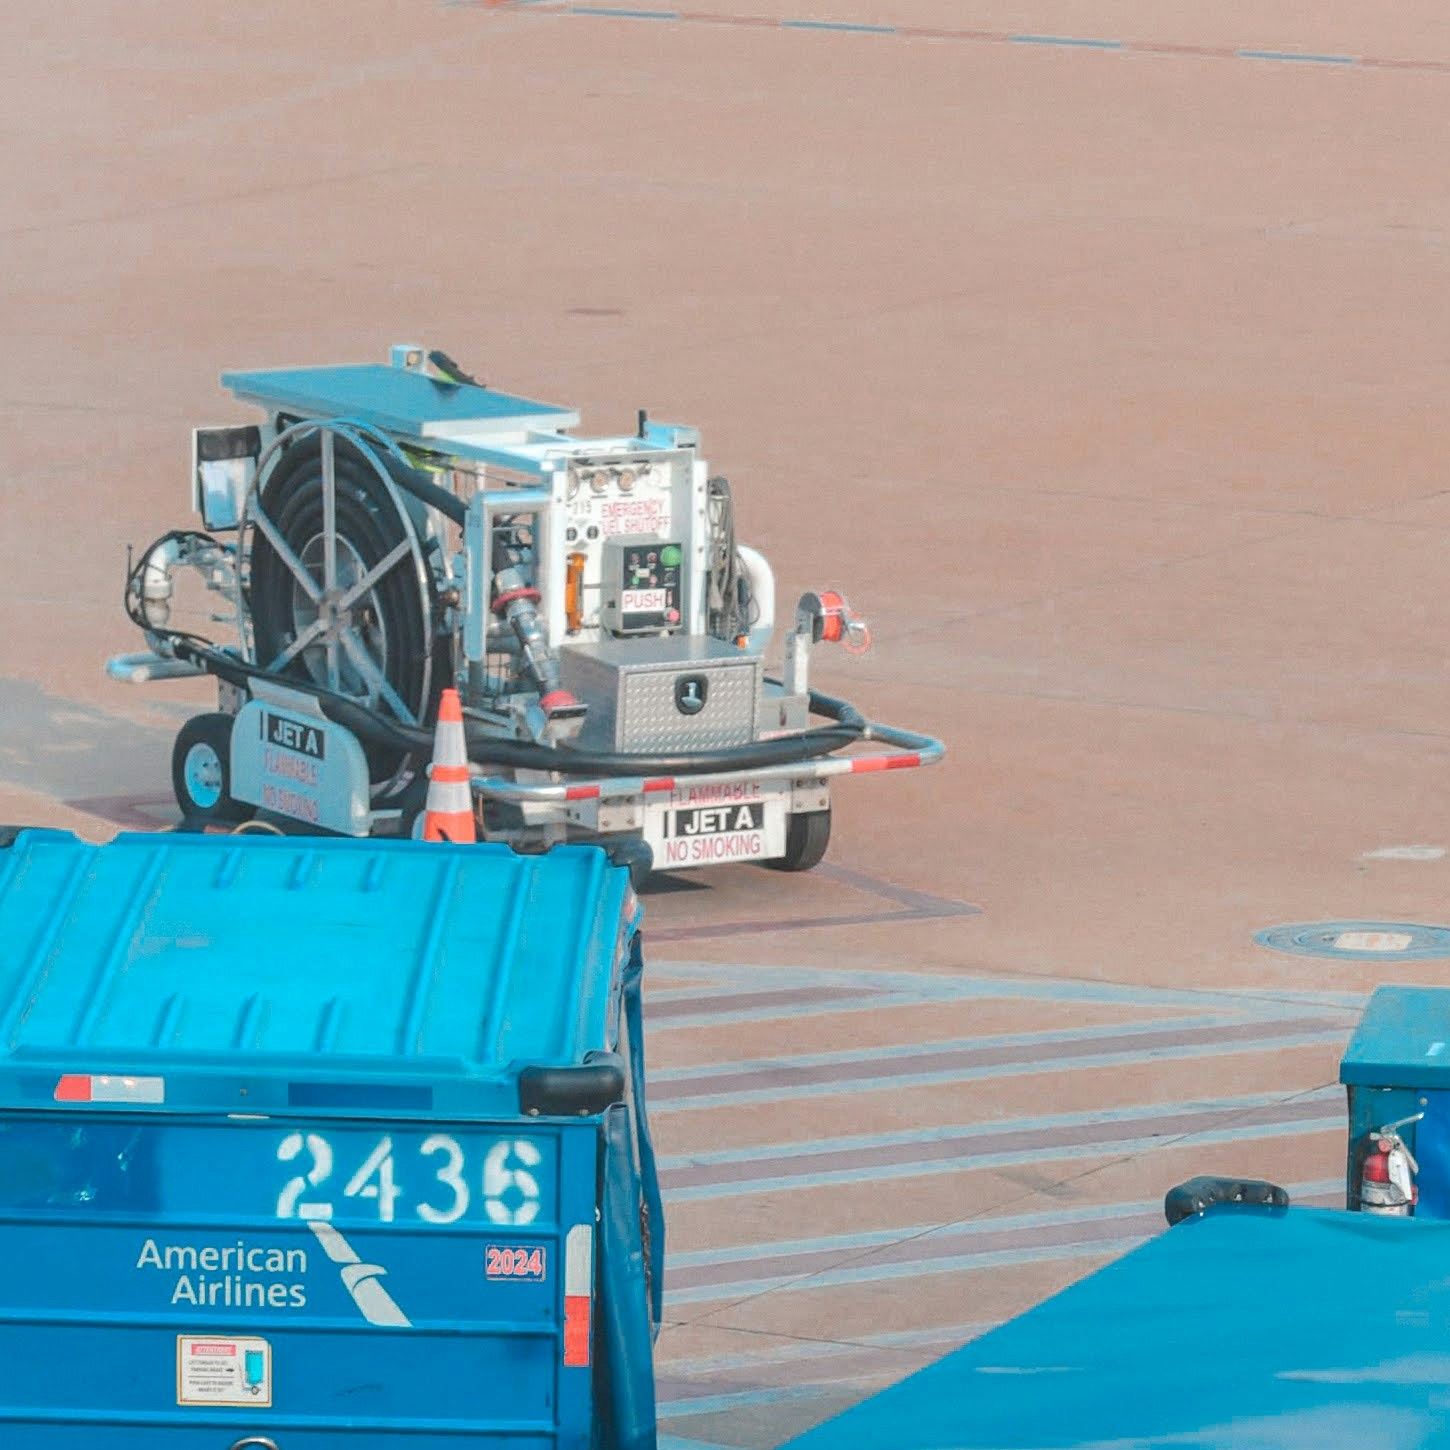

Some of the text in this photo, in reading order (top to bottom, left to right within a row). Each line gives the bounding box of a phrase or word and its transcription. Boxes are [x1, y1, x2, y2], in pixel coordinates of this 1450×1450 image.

[601, 499, 665, 518] EMERGENCY
[624, 514, 671, 535] SHUTOFF
[624, 592, 664, 610] PUSH
[273, 719, 318, 755] JET A
[670, 783, 762, 807] FLAMMABLE
[684, 805, 754, 834] JET A
[666, 833, 761, 863] NO SMOKING
[276, 1133, 542, 1226] 2436
[136, 1239, 307, 1273] American
[487, 1248, 542, 1275] 2024
[171, 1275, 307, 1307] Airlines
